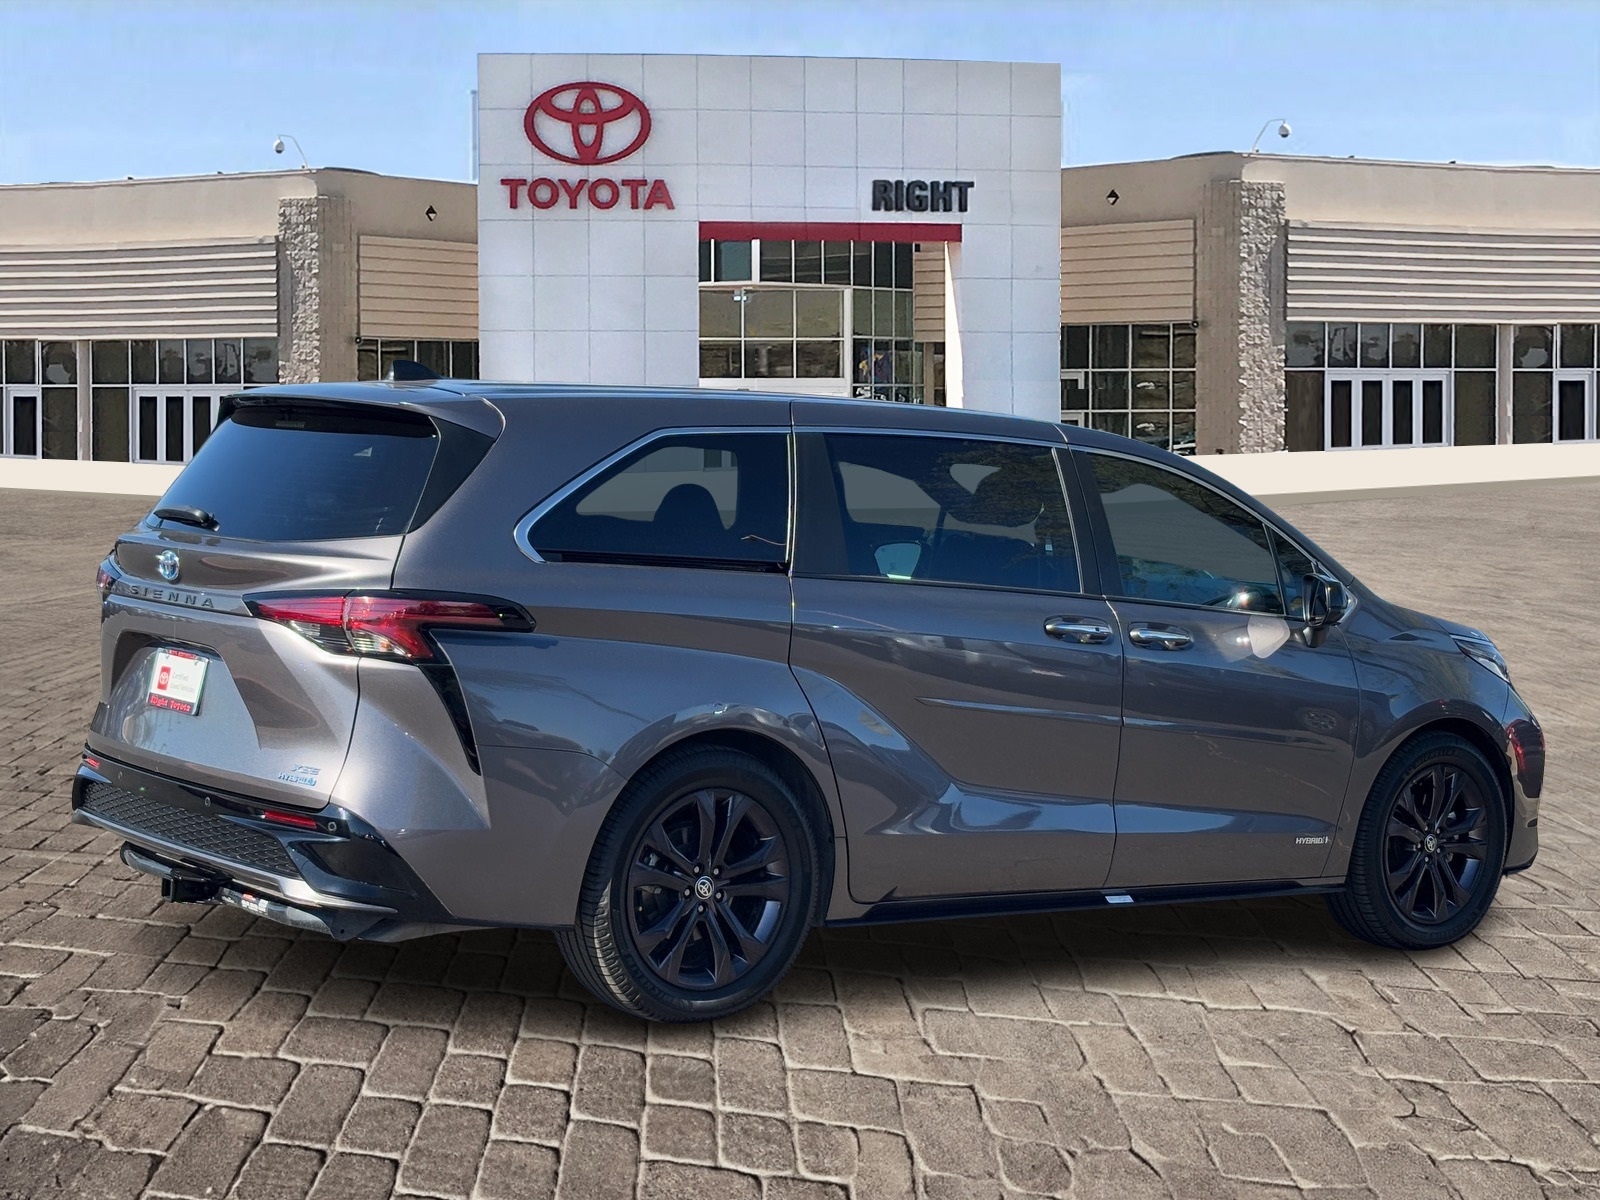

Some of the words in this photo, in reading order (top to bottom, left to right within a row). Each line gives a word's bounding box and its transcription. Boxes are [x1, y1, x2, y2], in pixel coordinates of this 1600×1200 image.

[500, 178, 676, 210] TOYOTA
[871, 179, 975, 213] RIGHT
[131, 585, 215, 608] SIENNA
[1295, 836, 1324, 845] HYBRID
